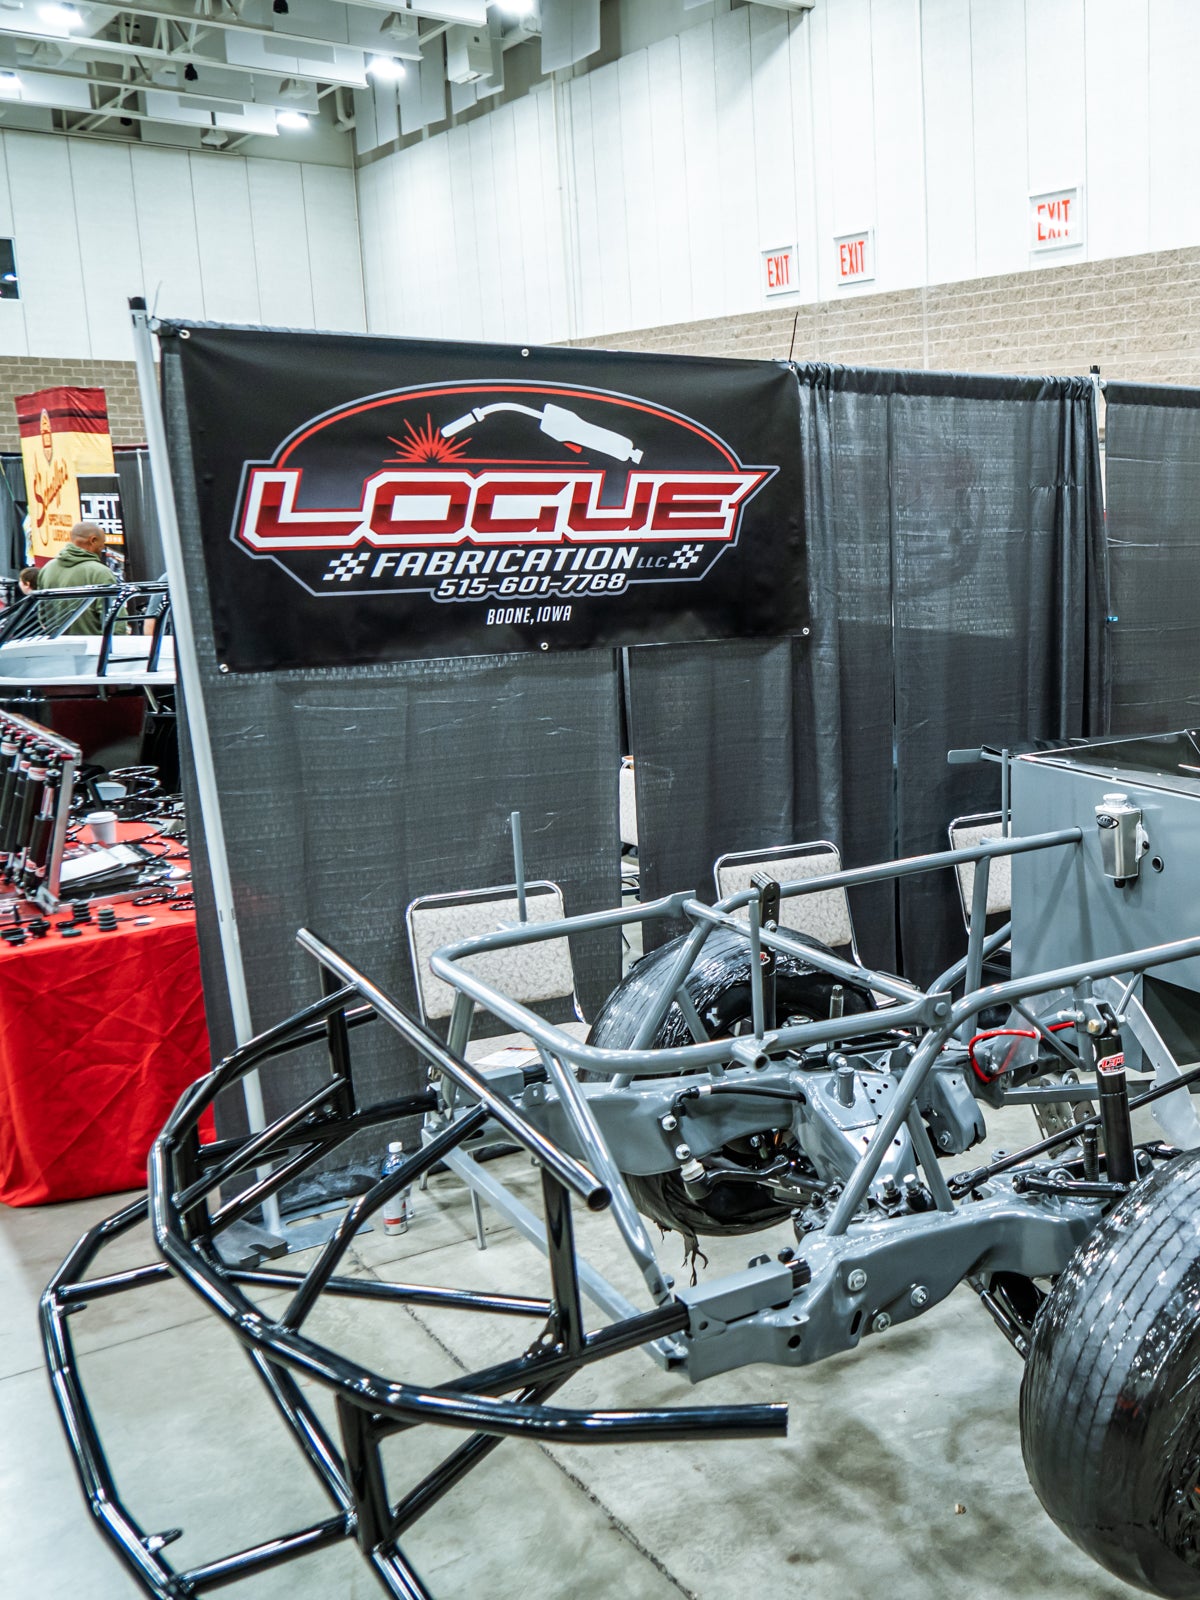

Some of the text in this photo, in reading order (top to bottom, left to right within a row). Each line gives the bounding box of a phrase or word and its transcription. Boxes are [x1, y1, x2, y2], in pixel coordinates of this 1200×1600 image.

[1037, 199, 1071, 241] EXIT
[767, 254, 790, 288] EXIT
[839, 241, 865, 276] EXIT
[240, 468, 768, 549] LOGUE
[371, 546, 668, 578] FABRICATION LLC
[437, 573, 626, 597] 515-601-7768
[536, 605, 572, 622] IOWA
